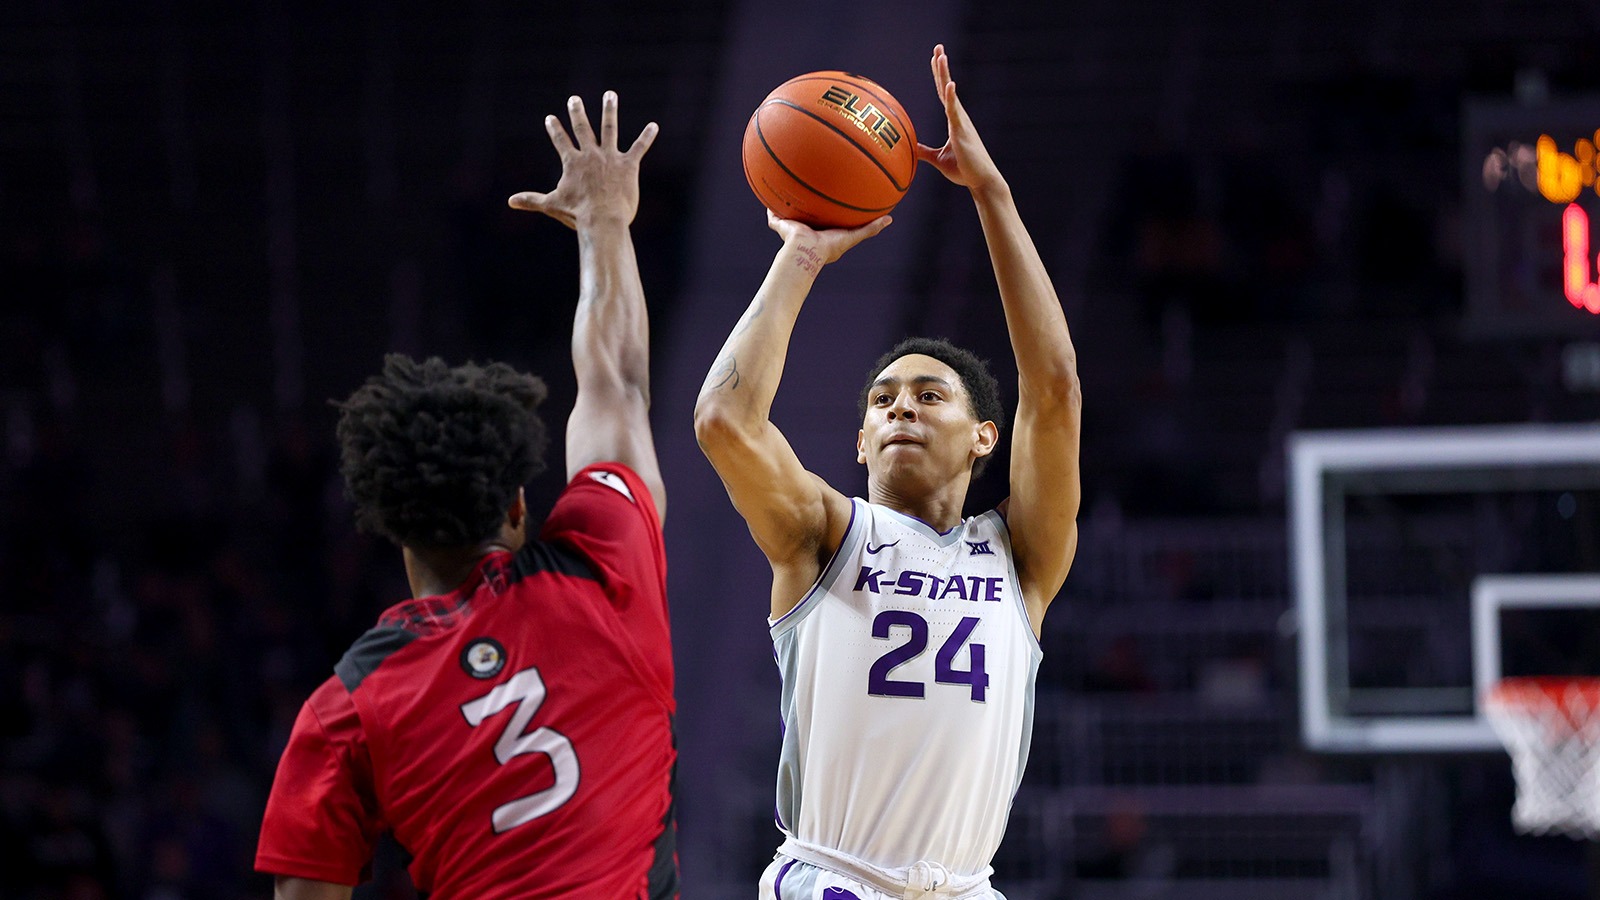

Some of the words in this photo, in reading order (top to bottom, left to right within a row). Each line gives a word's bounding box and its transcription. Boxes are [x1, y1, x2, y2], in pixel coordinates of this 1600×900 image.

[821, 85, 901, 150] ELITE
[853, 566, 1003, 602] K-STATE
[868, 610, 990, 703] 24
[459, 666, 581, 835] 3
